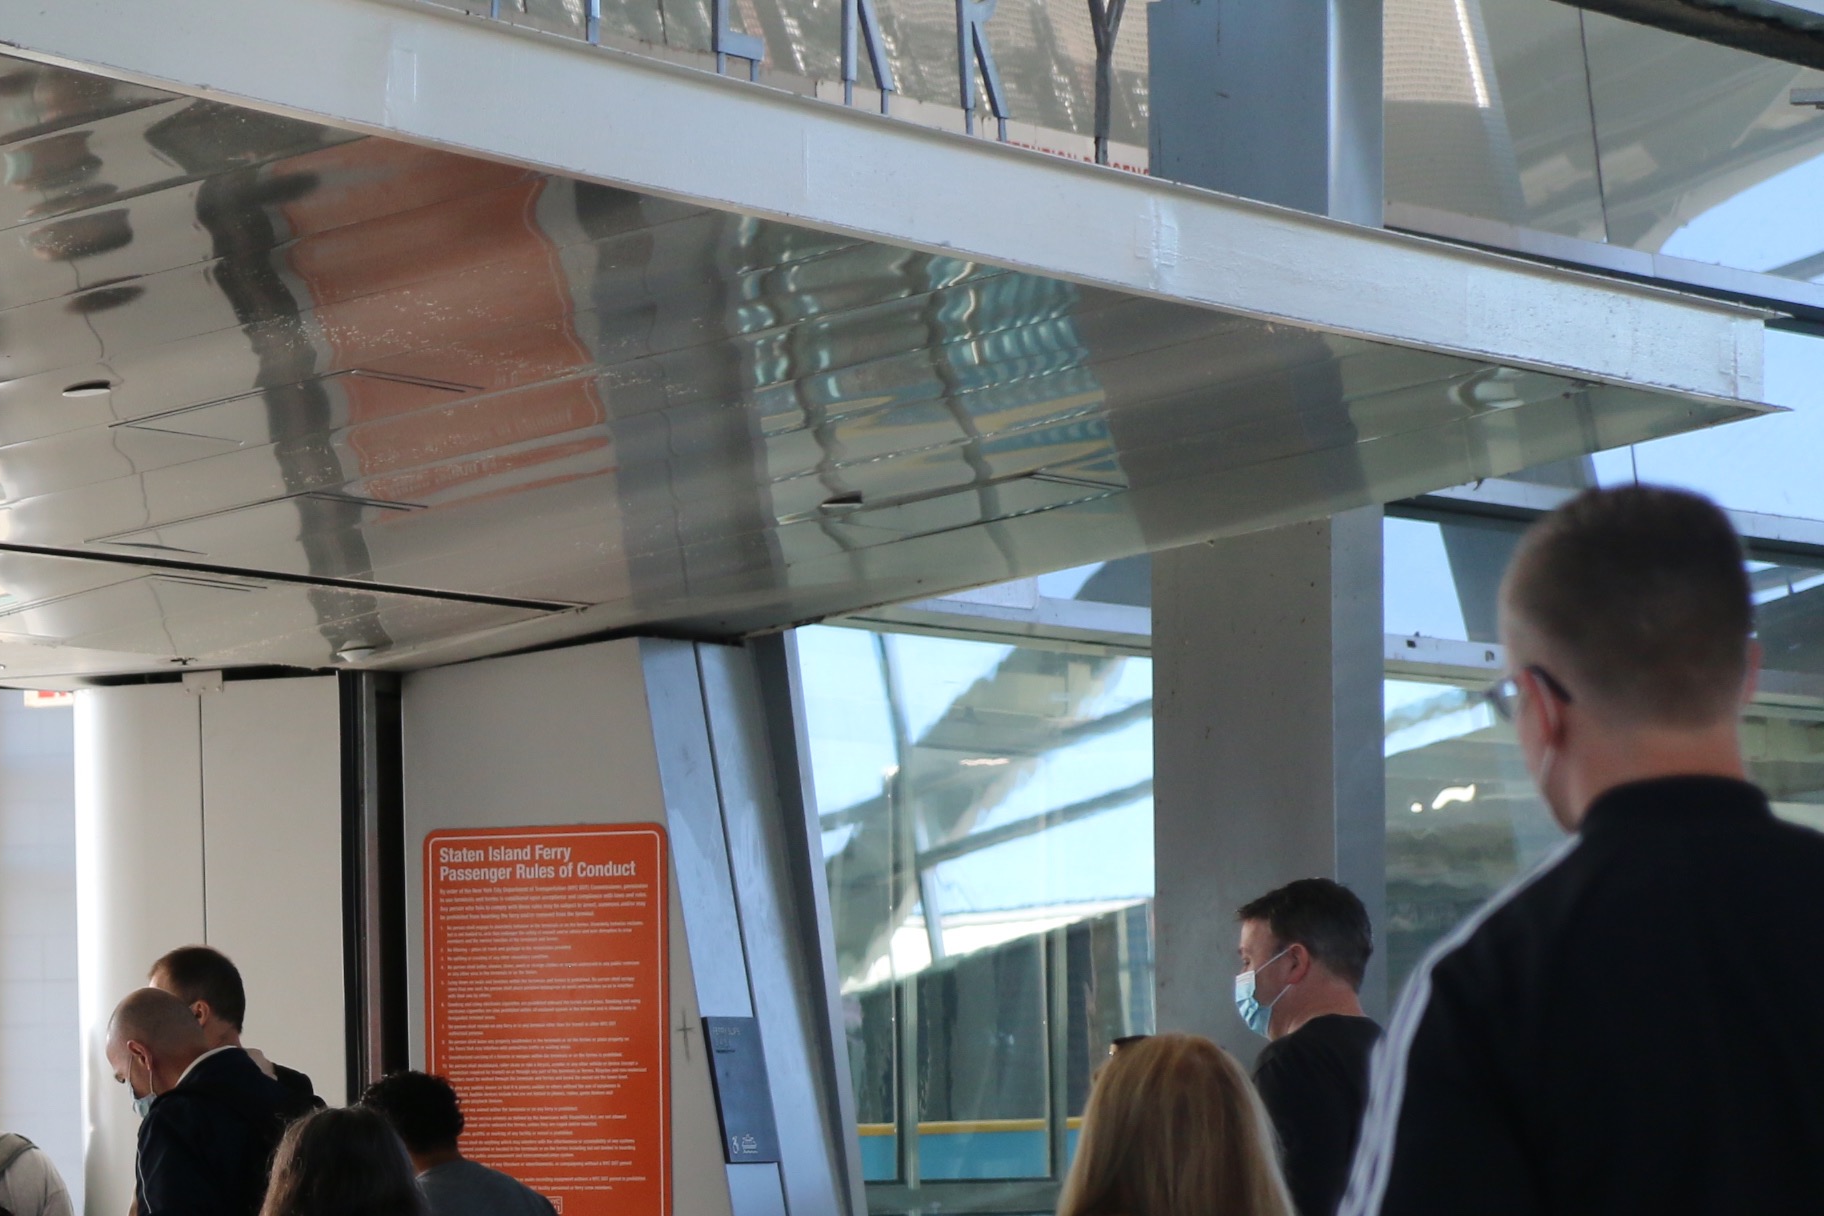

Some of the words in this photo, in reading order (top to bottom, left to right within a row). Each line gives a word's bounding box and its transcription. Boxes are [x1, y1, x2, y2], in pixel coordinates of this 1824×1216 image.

[439, 846, 484, 863] Staten
[489, 845, 531, 862] Island
[534, 844, 571, 864] Ferry
[439, 866, 511, 883] Passenger
[515, 864, 555, 880] Rules
[559, 862, 573, 878] of
[577, 860, 636, 878] Conduct
